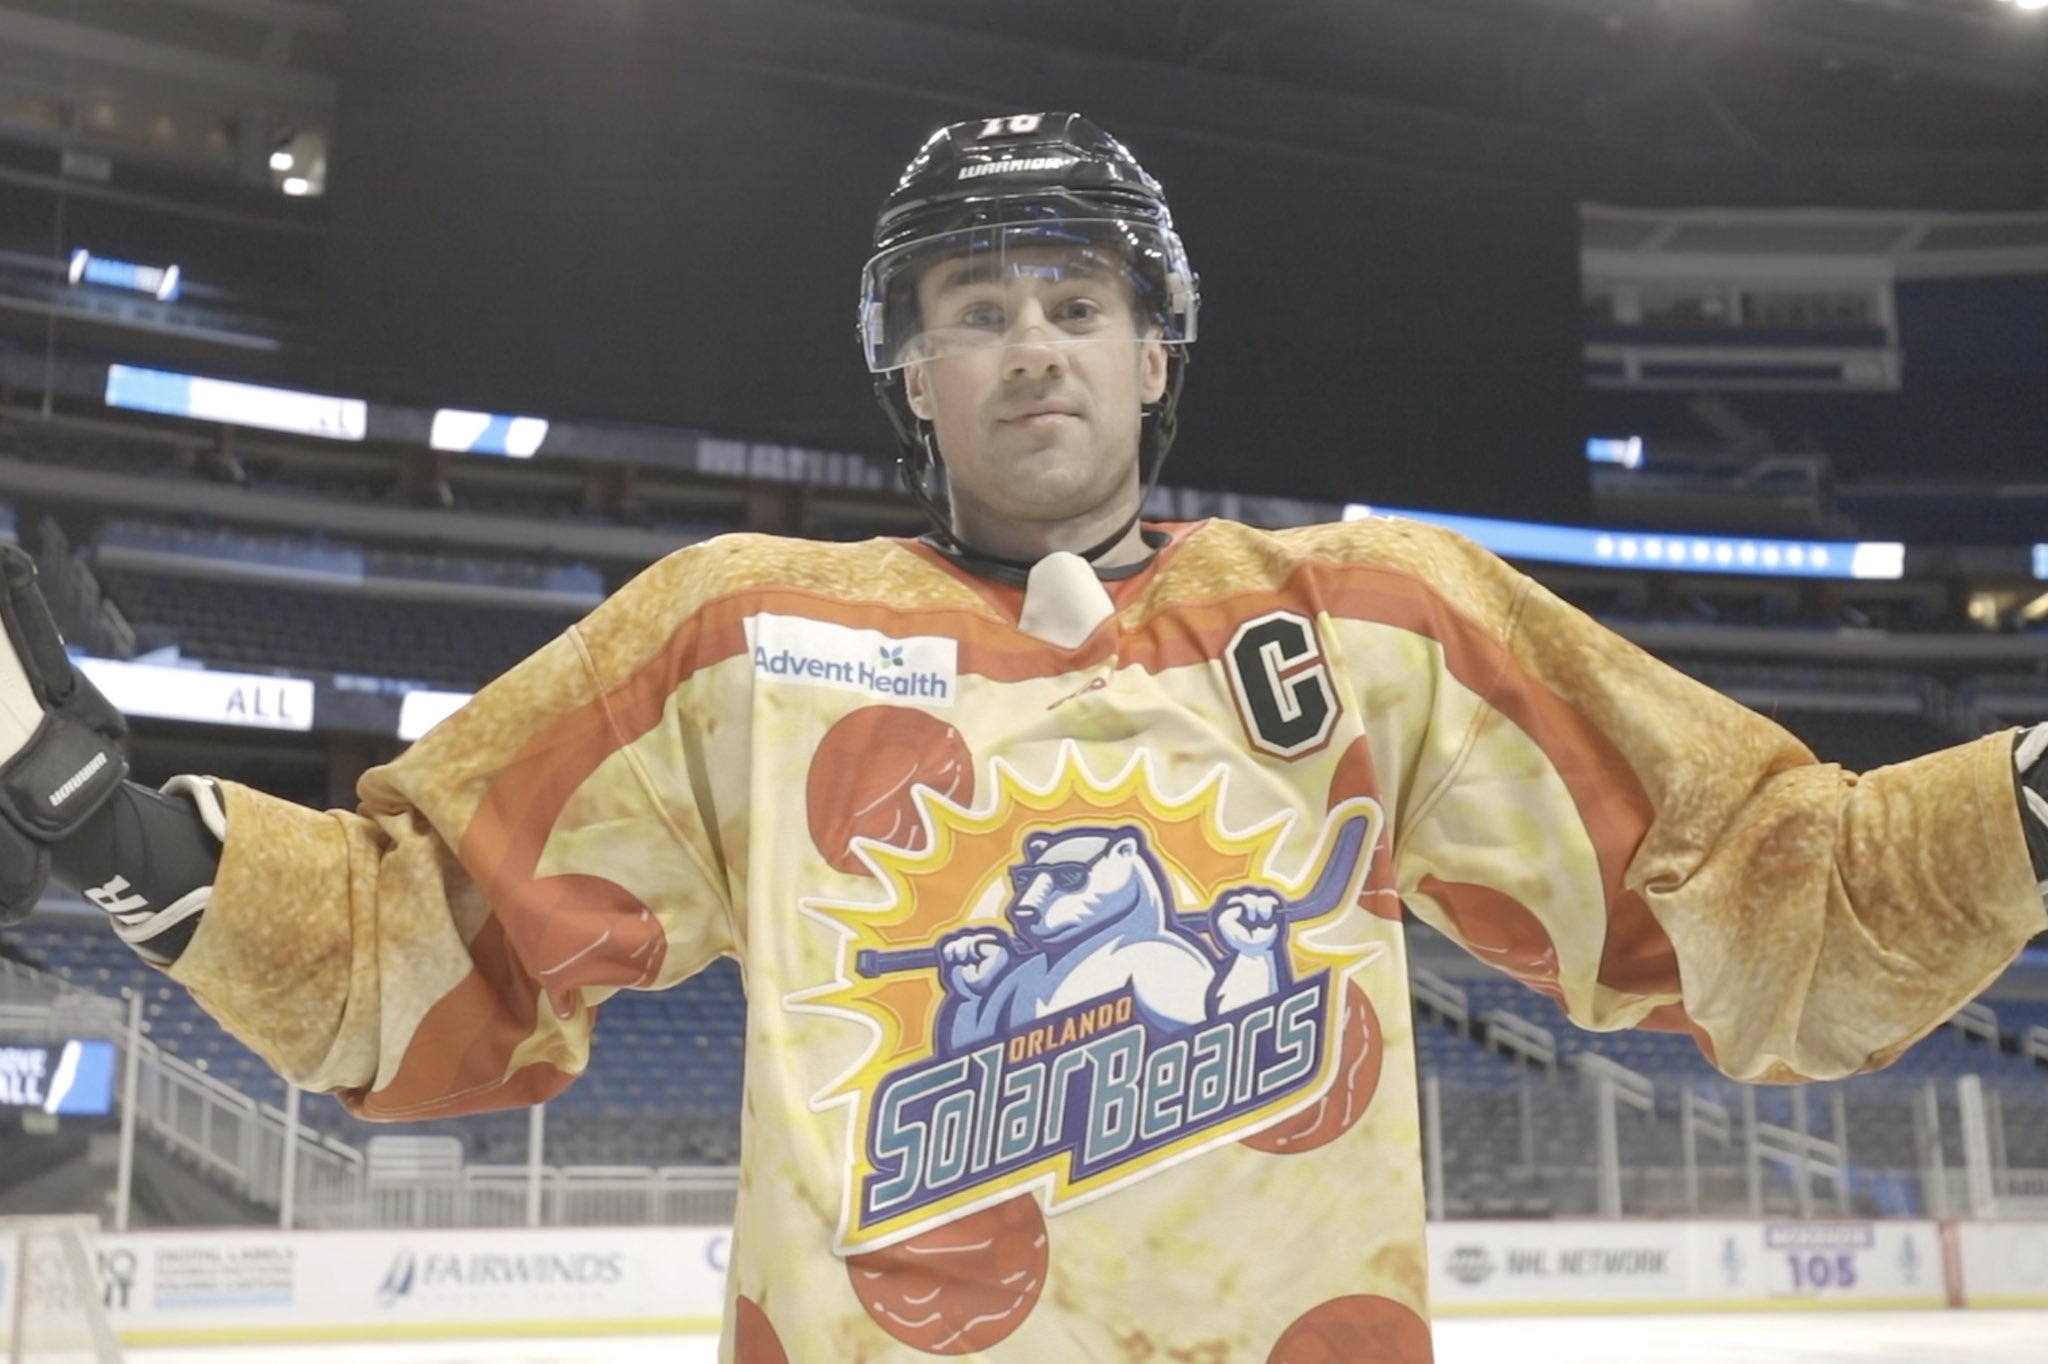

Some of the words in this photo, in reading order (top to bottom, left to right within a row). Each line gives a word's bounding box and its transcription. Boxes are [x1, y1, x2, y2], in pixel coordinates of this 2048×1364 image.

[958, 157, 1063, 180] WARRIOR
[1225, 611, 1338, 757] C
[225, 685, 295, 719] ALL
[1009, 996, 1133, 1064] ORLANDO
[423, 1252, 625, 1286] FAIRWINDS
[1505, 1248, 1549, 1276] NHL
[1559, 1248, 1671, 1276] NETWORK
[1787, 1254, 1856, 1288] 105
